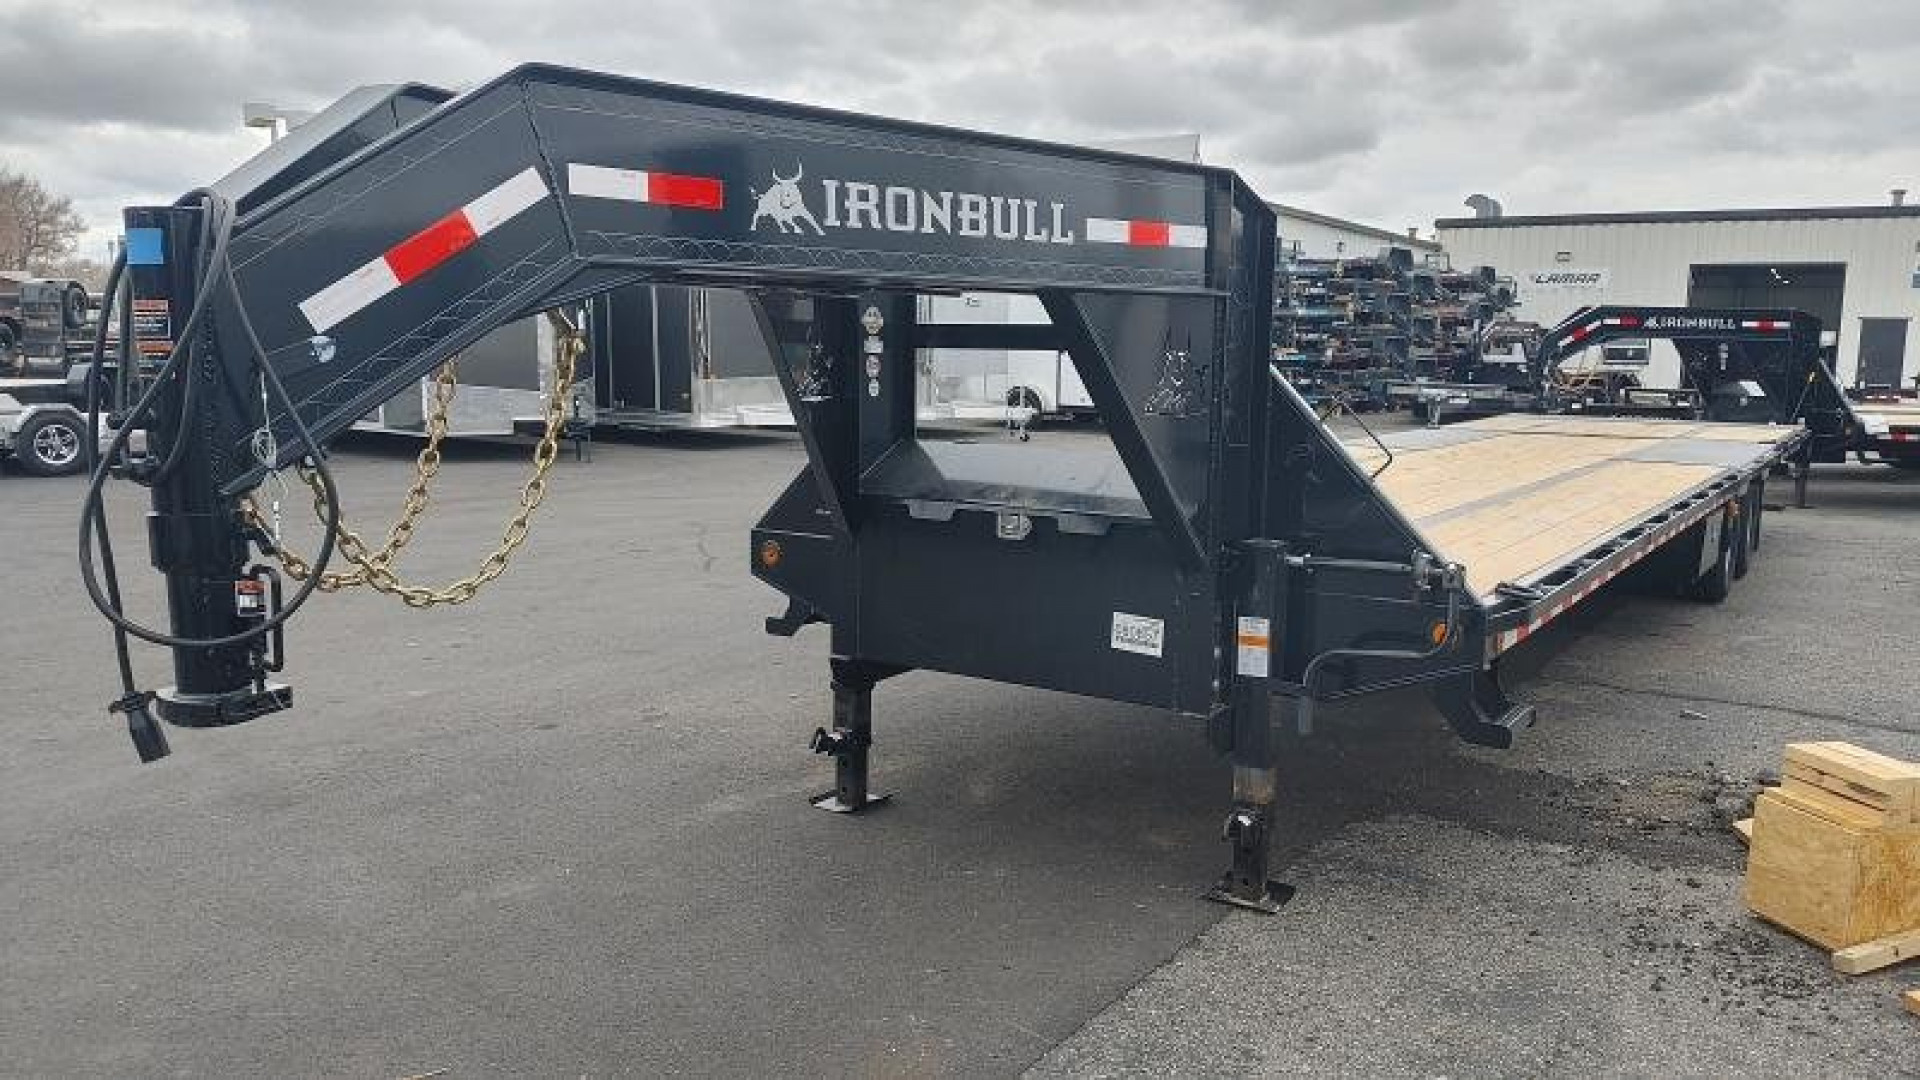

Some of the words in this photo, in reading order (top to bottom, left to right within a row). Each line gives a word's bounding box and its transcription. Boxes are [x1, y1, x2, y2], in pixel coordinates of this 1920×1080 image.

[823, 179, 1074, 244] IRONBULL
[1535, 273, 1601, 284] LAMAR
[1660, 316, 1736, 330] IRONBULL
